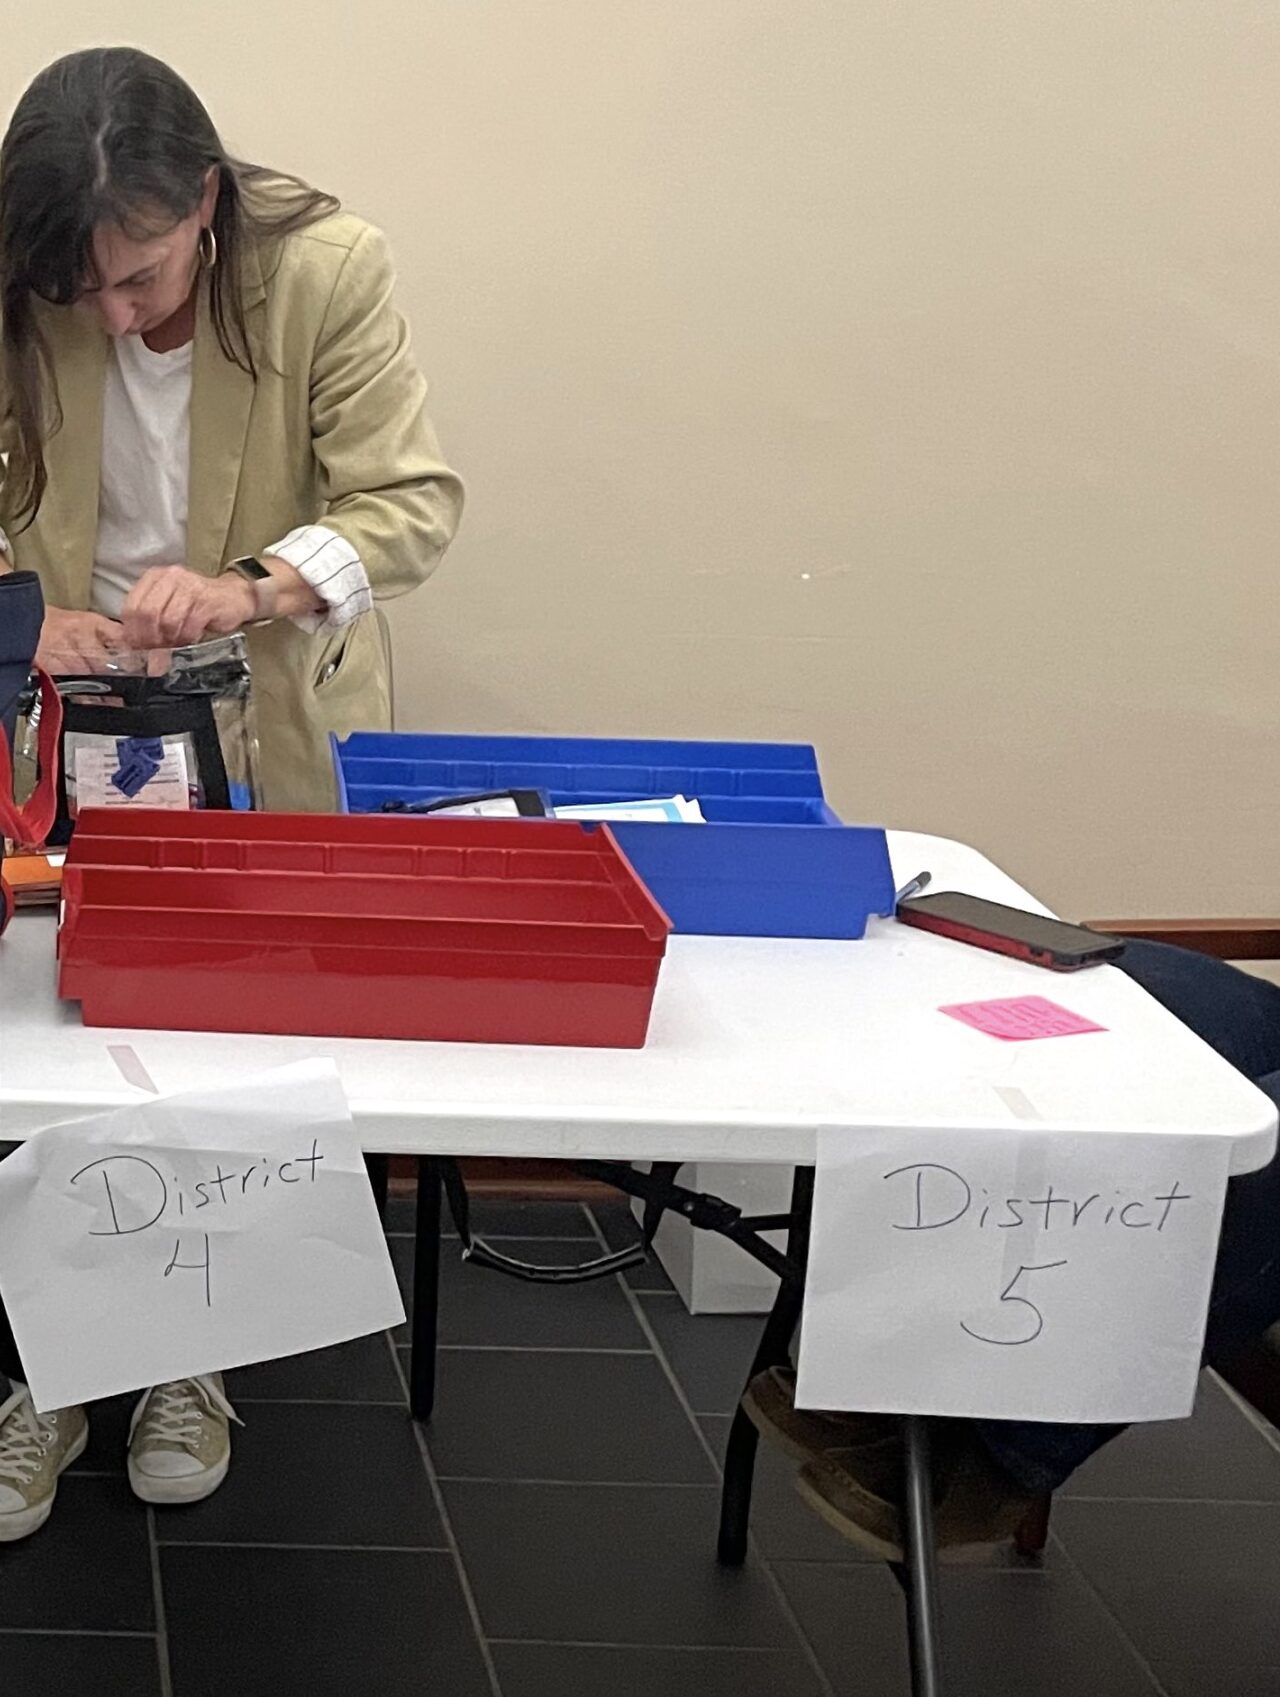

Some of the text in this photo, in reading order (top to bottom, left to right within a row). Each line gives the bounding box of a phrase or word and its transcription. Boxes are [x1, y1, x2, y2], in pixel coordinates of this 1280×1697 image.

[70, 1138, 324, 1235] District
[883, 1163, 1191, 1231] District
[163, 1232, 211, 1307] 4
[959, 1259, 1068, 1345] 5
